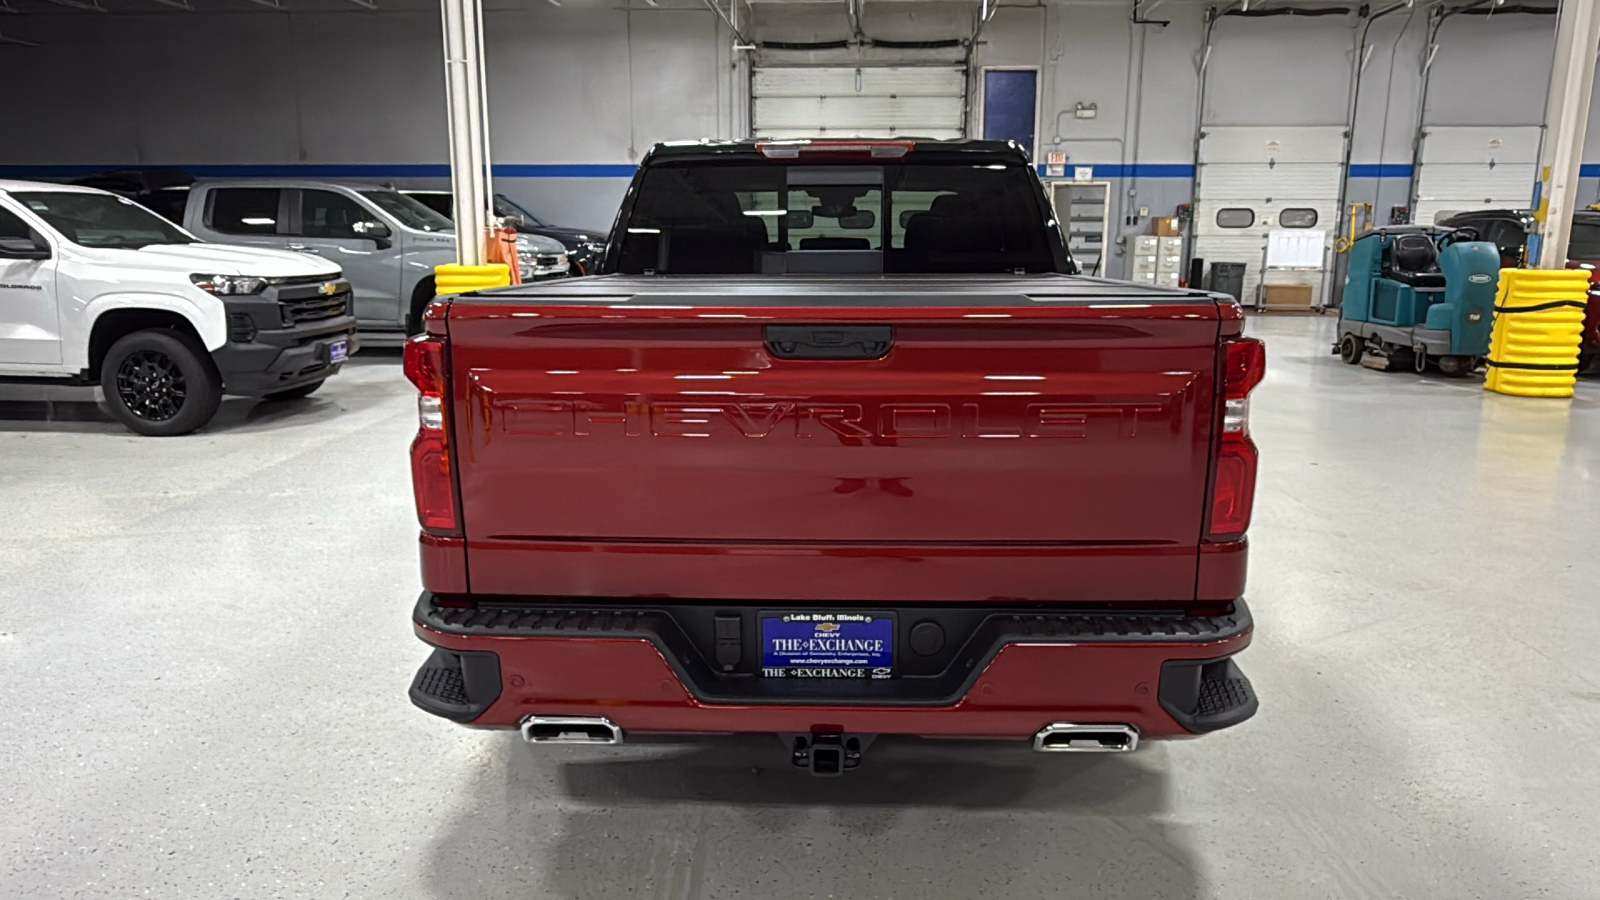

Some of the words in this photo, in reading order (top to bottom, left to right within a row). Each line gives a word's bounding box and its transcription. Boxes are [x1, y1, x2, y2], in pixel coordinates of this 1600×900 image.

[501, 400, 1164, 439] CHEVROLET
[790, 613, 811, 621] Lake
[836, 613, 864, 621] Illinois
[772, 639, 802, 651] THE
[809, 639, 883, 652] EXCHANGE
[762, 668, 786, 678] THE
[797, 668, 865, 678] EXCHANGE
